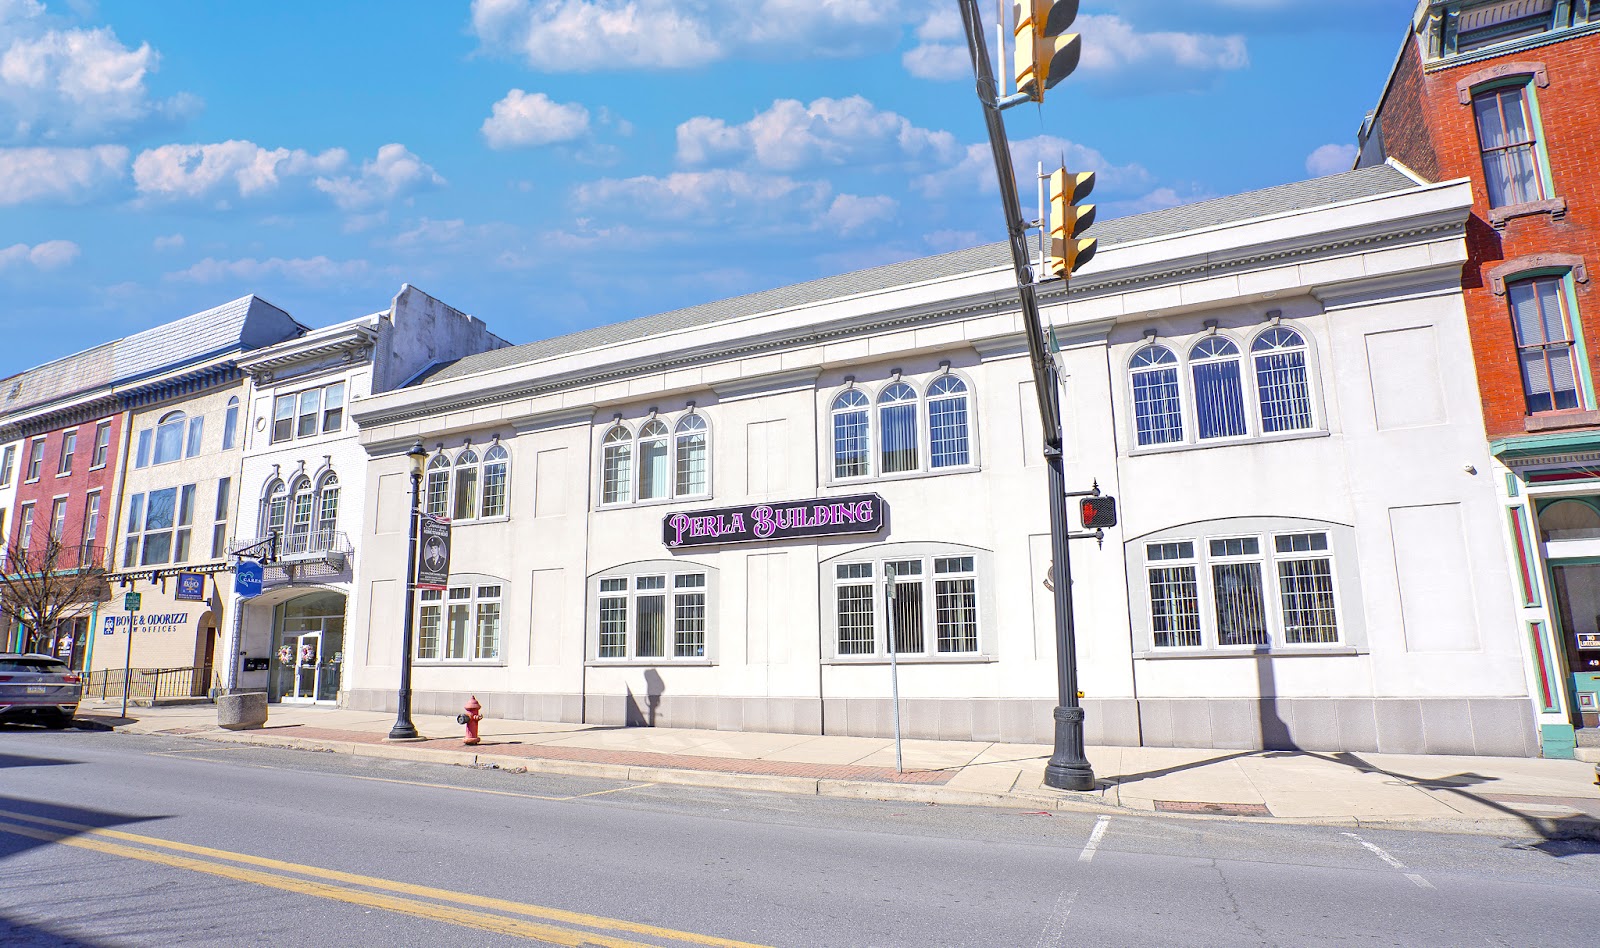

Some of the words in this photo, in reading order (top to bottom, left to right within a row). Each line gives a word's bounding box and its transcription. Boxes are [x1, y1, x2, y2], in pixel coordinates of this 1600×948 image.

[669, 513, 746, 547] PERLA
[751, 500, 873, 538] BUILDING
[139, 615, 145, 625] &
[147, 613, 188, 625] ODORIZZI
[142, 625, 176, 633] OFFICES
